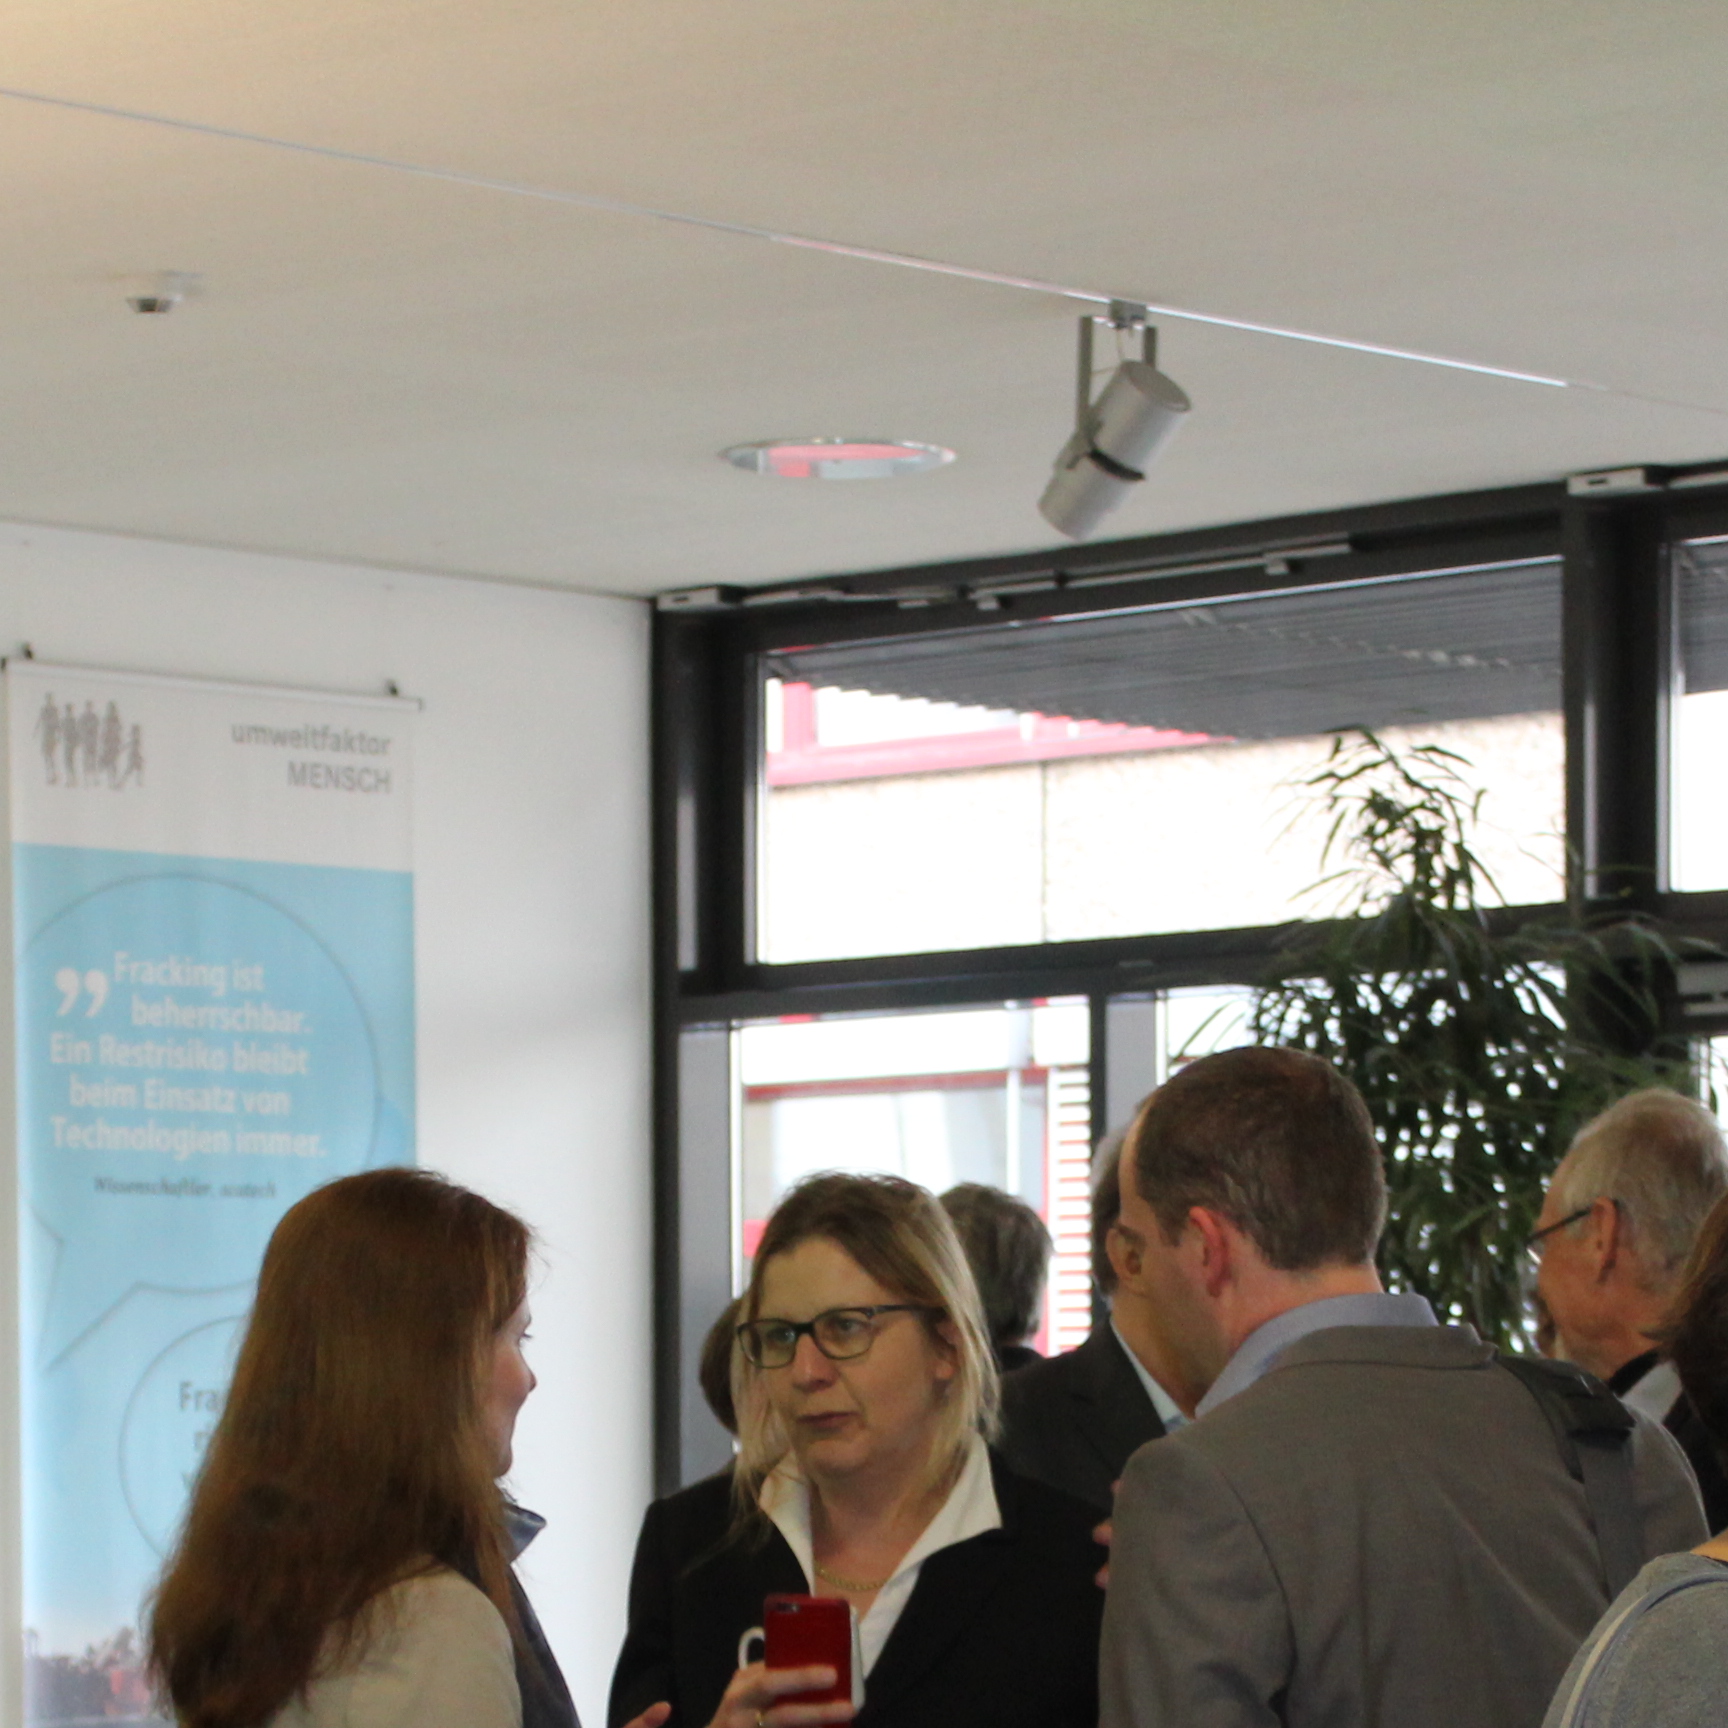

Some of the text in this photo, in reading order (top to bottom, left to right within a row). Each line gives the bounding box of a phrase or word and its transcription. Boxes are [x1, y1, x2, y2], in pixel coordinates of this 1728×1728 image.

[231, 723, 391, 756] umweltfaktor
[288, 760, 391, 794] MENSCH
[114, 951, 265, 997] Fracking ist
[131, 994, 313, 1034] beherrschbar.
[50, 1032, 309, 1075] Ein Restrisiko bleibt
[70, 1072, 291, 1115] beim Einsatz von
[51, 1115, 327, 1161] Technologien immer.
